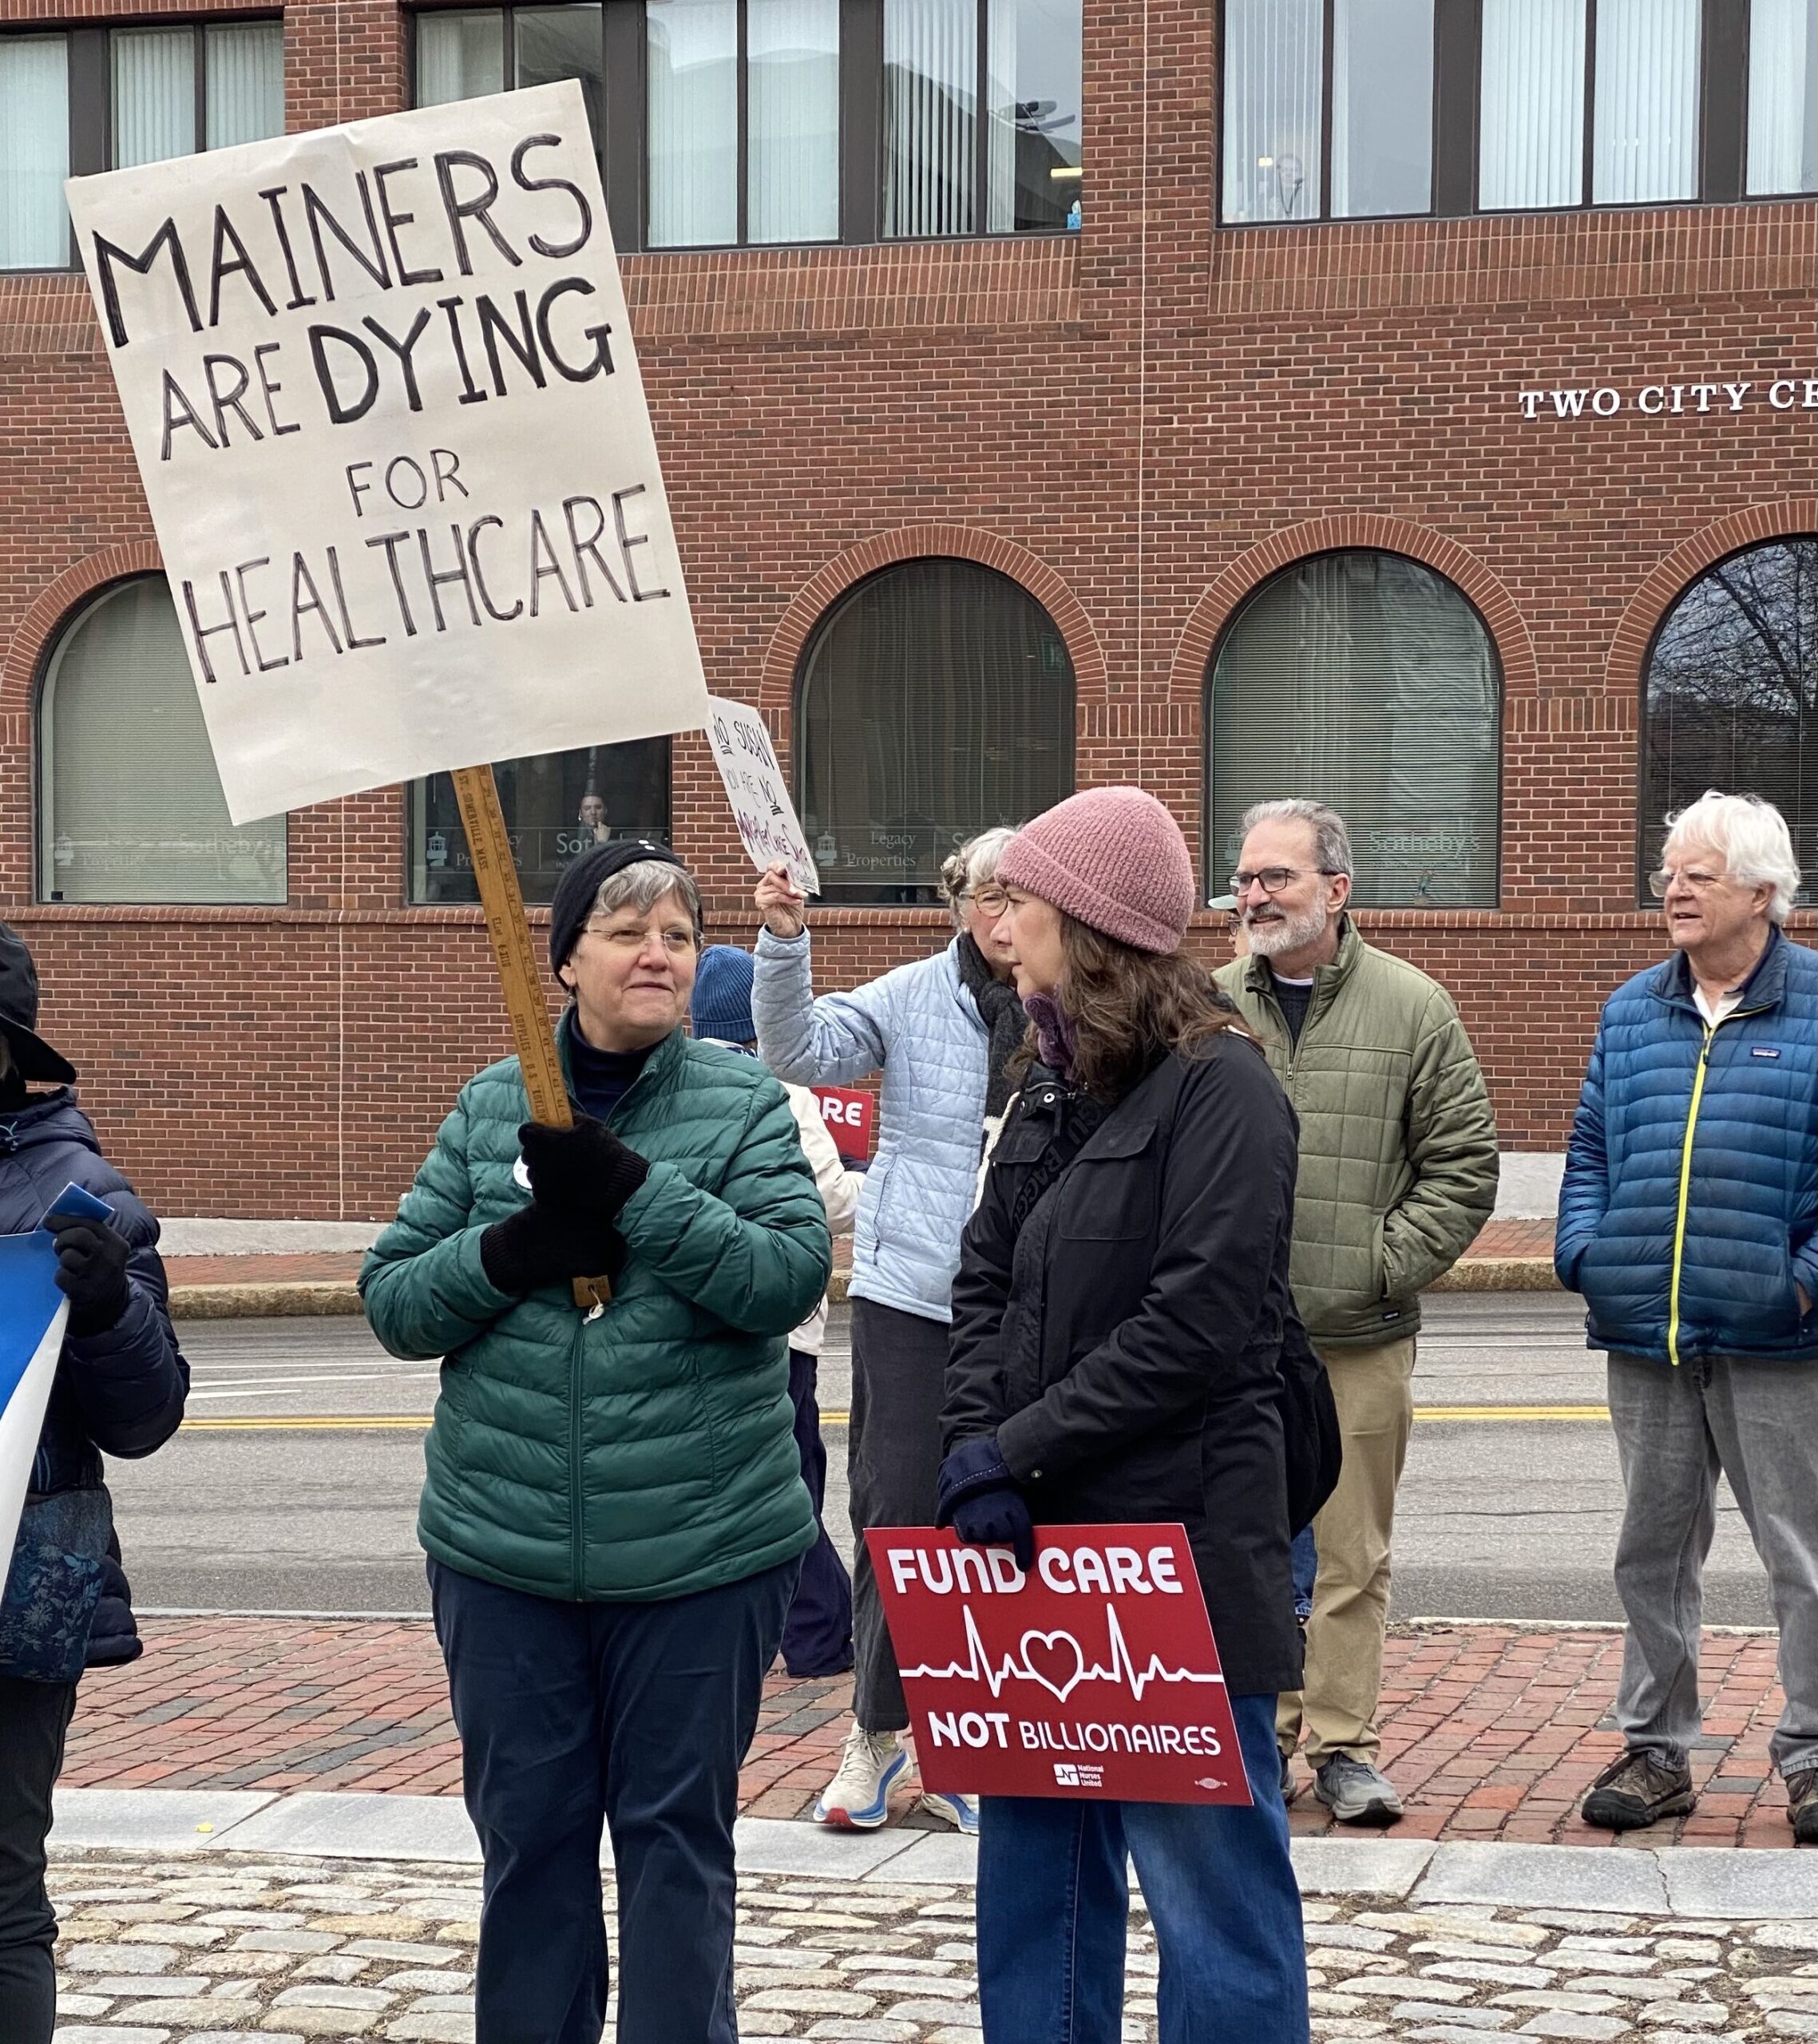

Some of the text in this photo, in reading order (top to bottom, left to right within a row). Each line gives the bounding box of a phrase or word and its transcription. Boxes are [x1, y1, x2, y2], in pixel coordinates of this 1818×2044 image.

[92, 133, 592, 348] MAINERS
[160, 276, 617, 461] ARE DYING
[1518, 387, 1622, 419] TWO
[1638, 382, 1753, 414] CITY
[345, 448, 469, 517] FOR
[181, 483, 671, 683] HEALTHCARE
[713, 713, 775, 770] NO SUSAN
[758, 775, 778, 806] NO
[870, 831, 917, 849] Legacy
[1369, 830, 1479, 858] Sotheby's
[847, 852, 917, 870] Properties
[822, 1096, 863, 1127] RE
[887, 1547, 1184, 1594] FUND CARE
[928, 1711, 1222, 1756] NOT BILLIONAIRES
[1078, 1764, 1104, 1773] National
